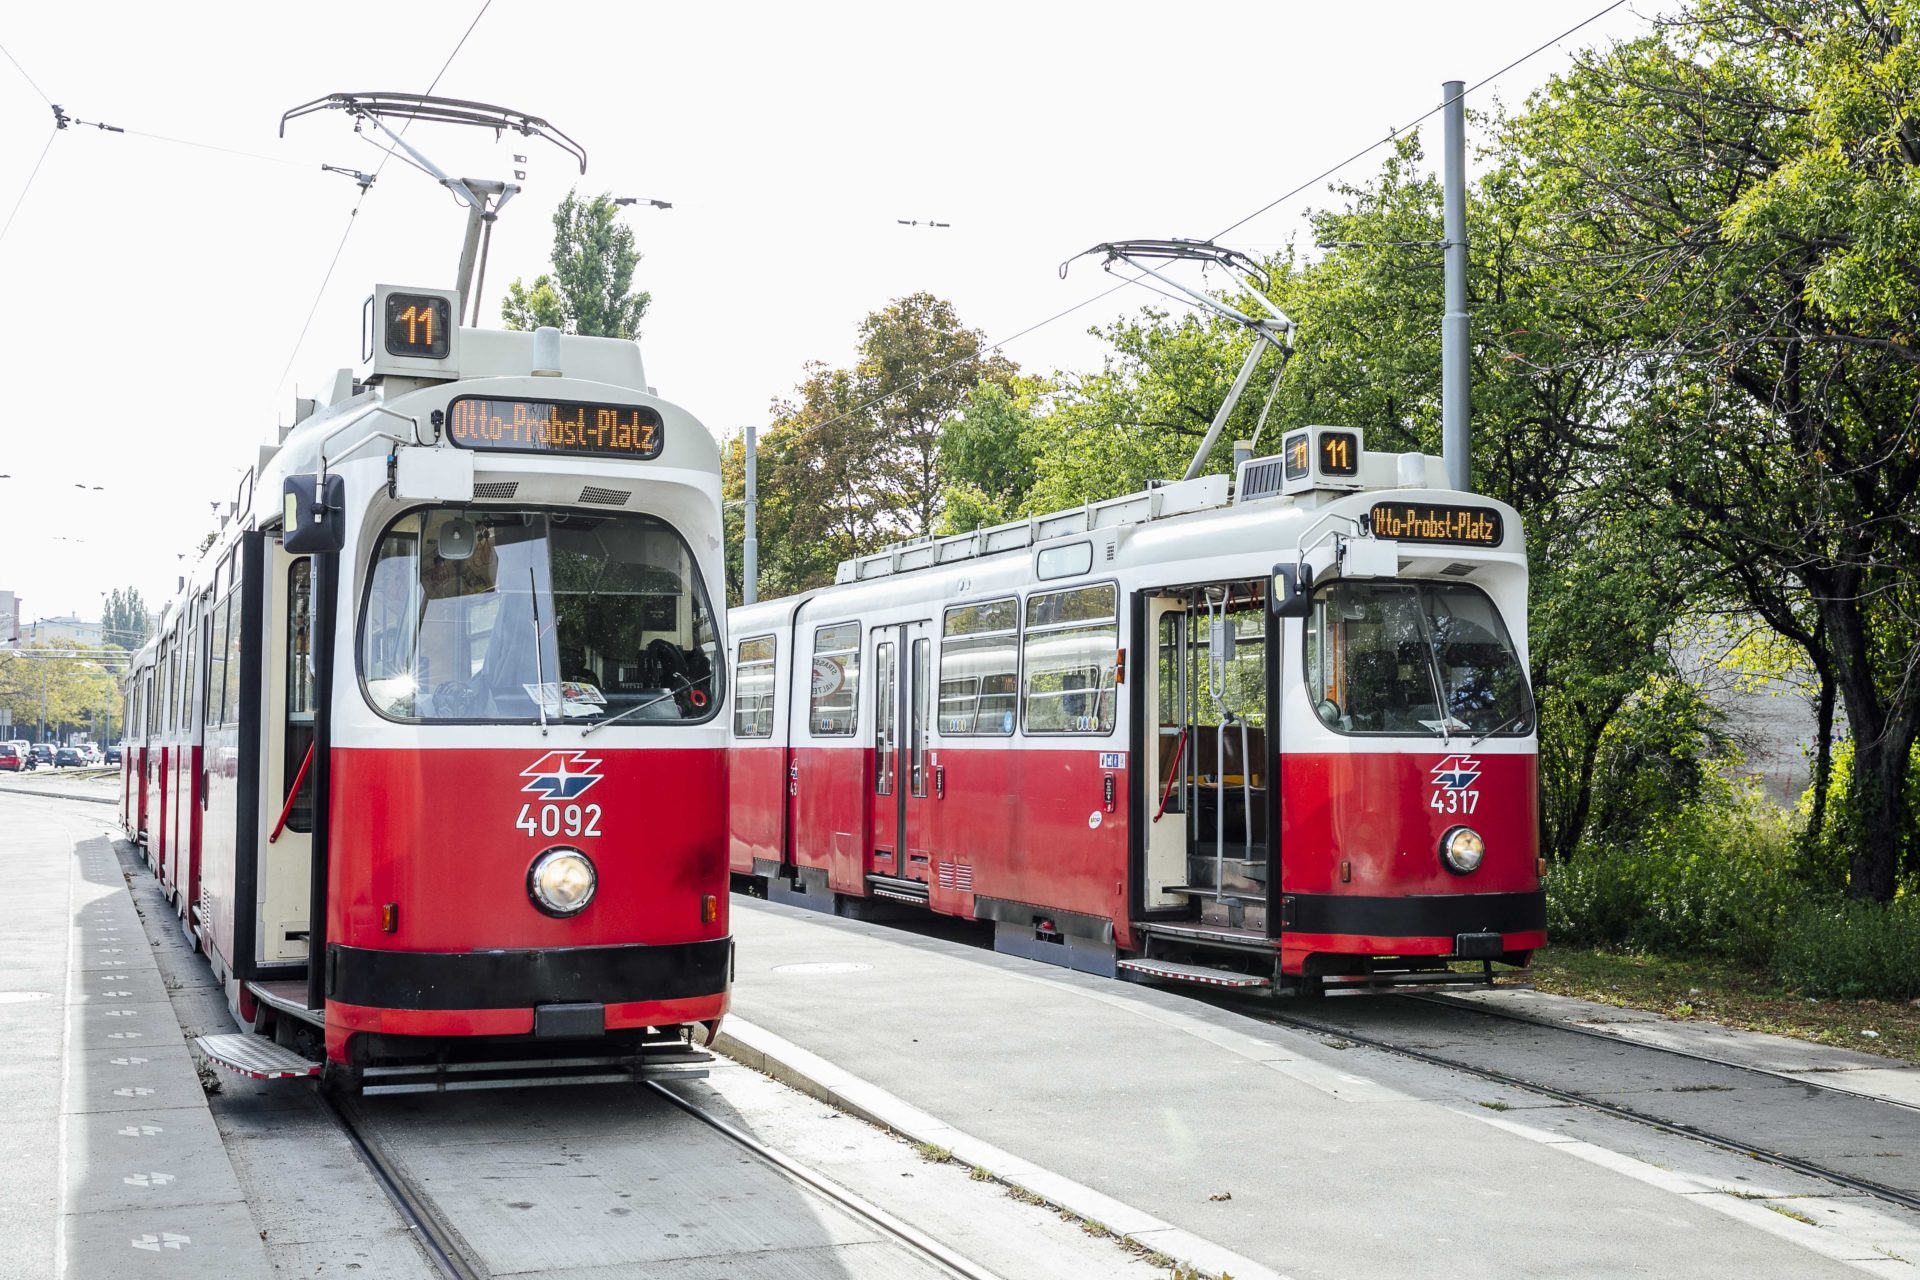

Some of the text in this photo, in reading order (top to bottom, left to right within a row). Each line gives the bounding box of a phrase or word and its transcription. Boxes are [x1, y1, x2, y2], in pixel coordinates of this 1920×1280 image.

[401, 306, 433, 345] 11
[453, 400, 654, 449] Otto-Probst-Platz
[1295, 442, 1307, 469] 11
[1326, 440, 1347, 467] 11
[1373, 507, 1493, 539] Otto-Probst-Platz
[1430, 790, 1480, 814] 4317
[515, 803, 602, 837] 4092
